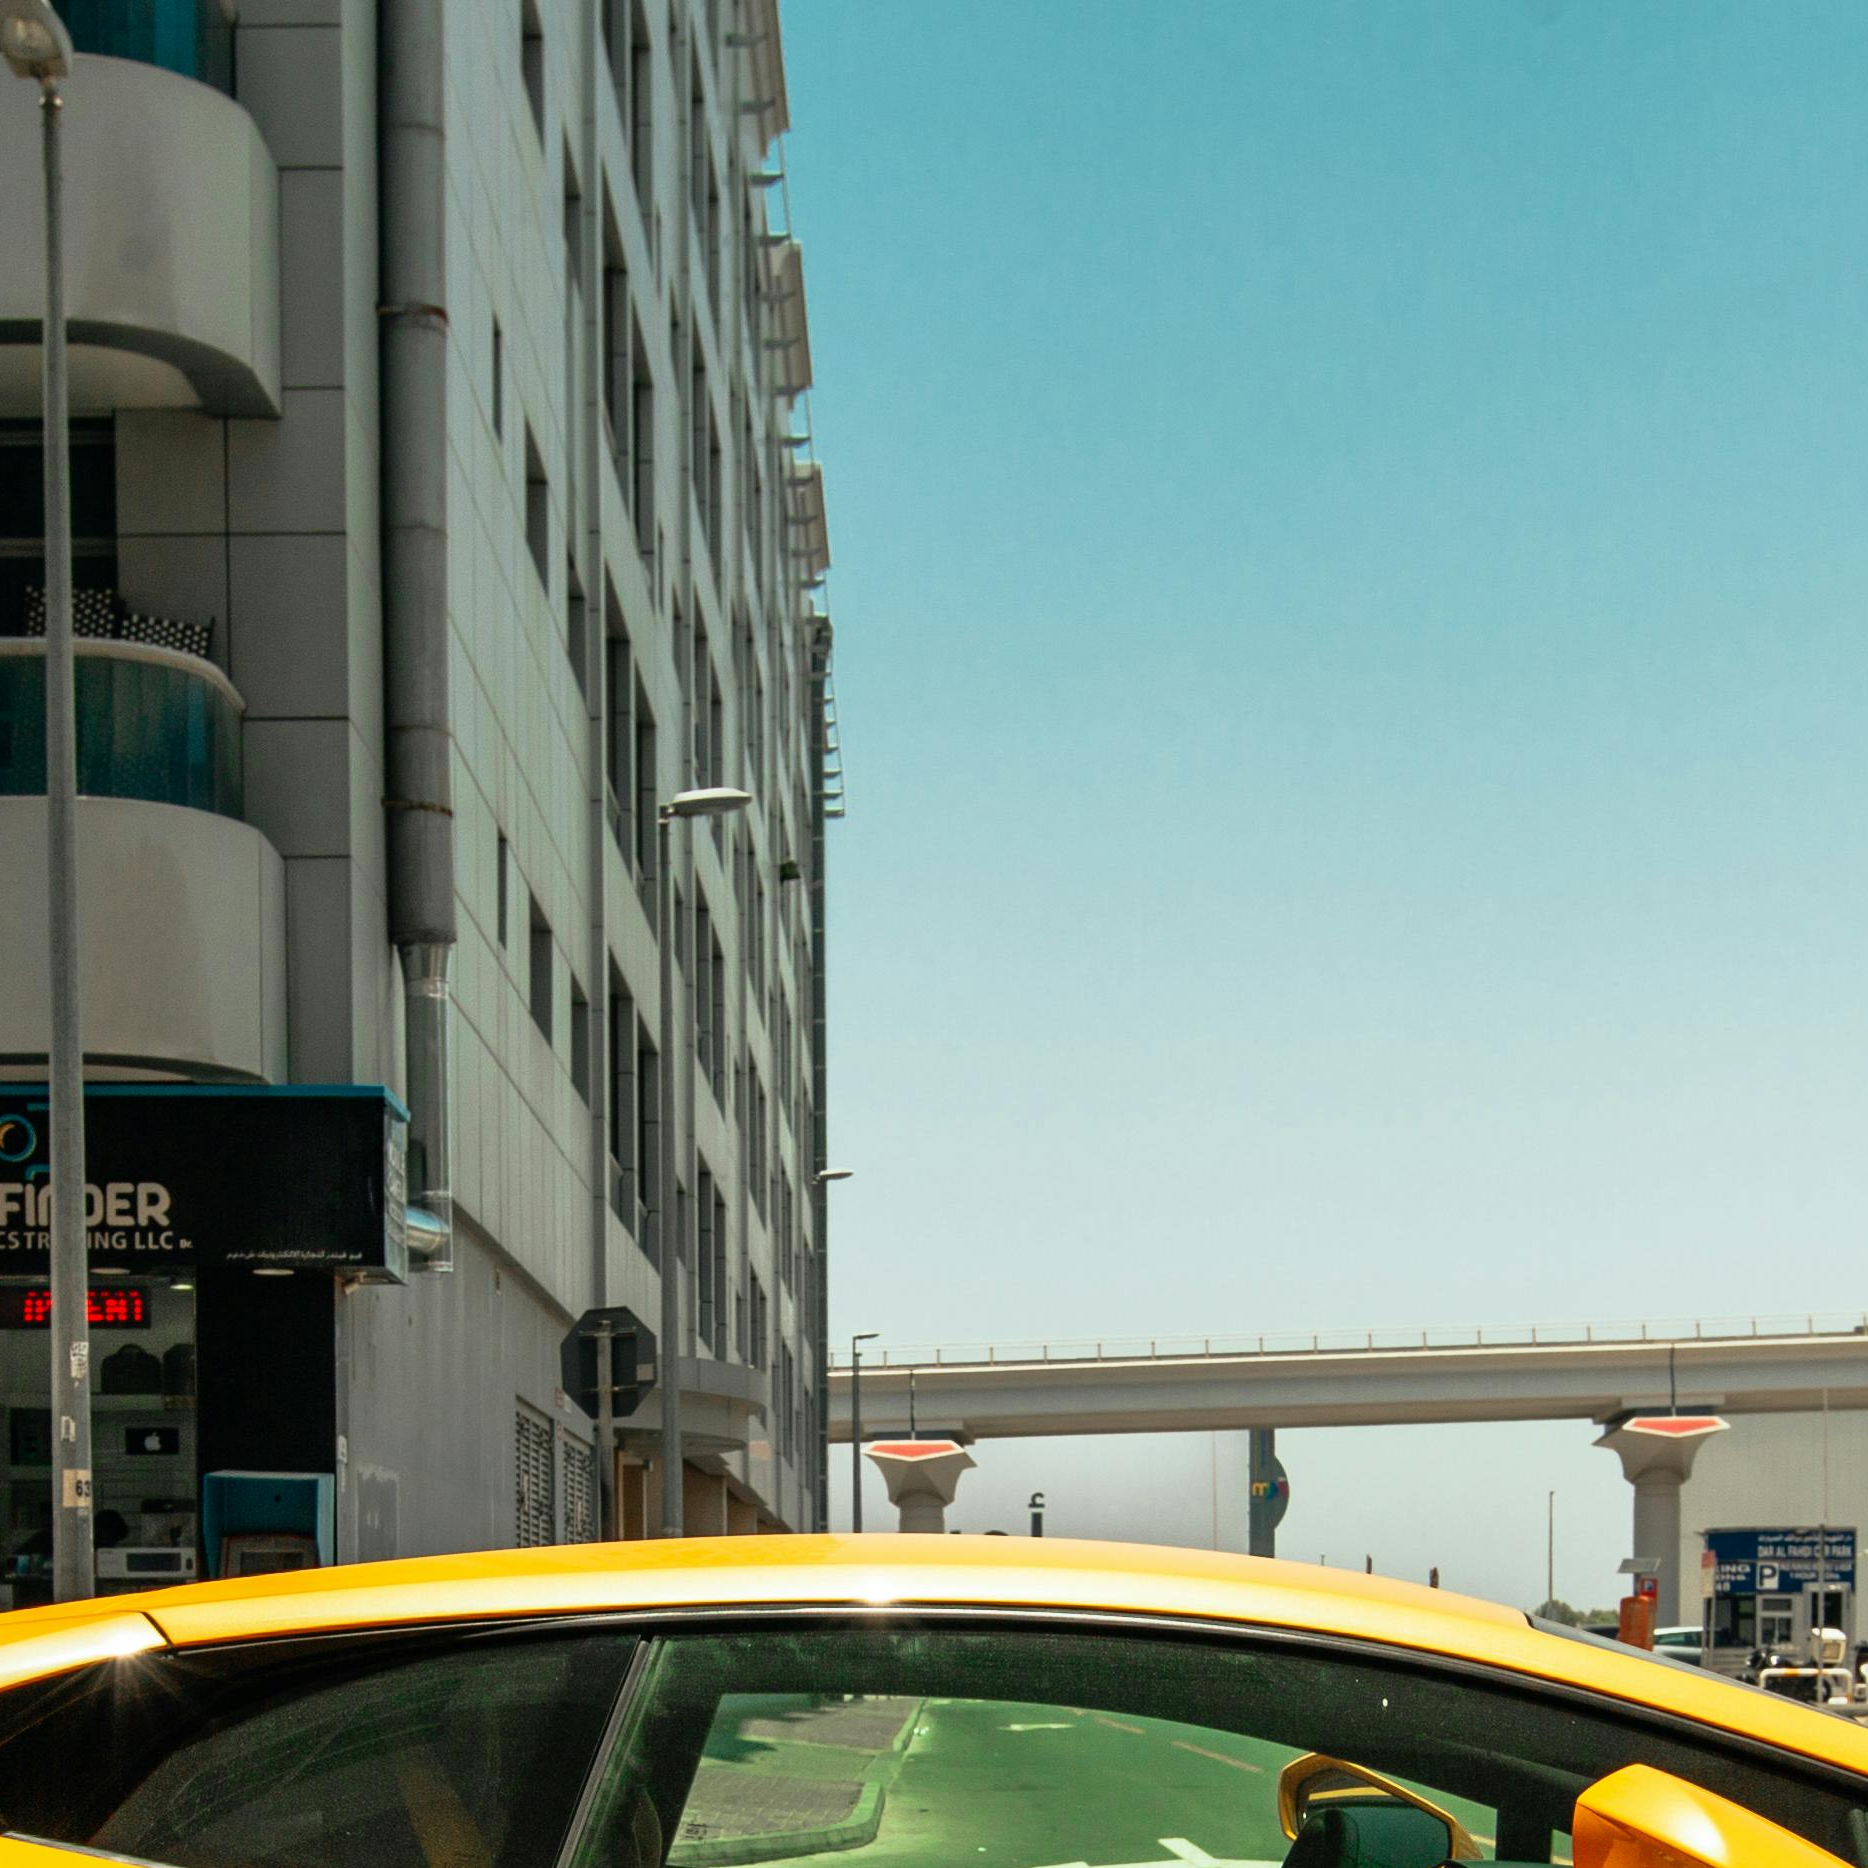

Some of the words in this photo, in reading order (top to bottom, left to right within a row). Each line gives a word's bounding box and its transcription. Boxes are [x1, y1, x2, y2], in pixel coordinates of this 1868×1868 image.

[24, 1230, 128, 1250] TRING
[135, 1230, 174, 1250] LLC
[1813, 1545, 1830, 1558] CR
[1759, 1565, 1777, 1588] P
